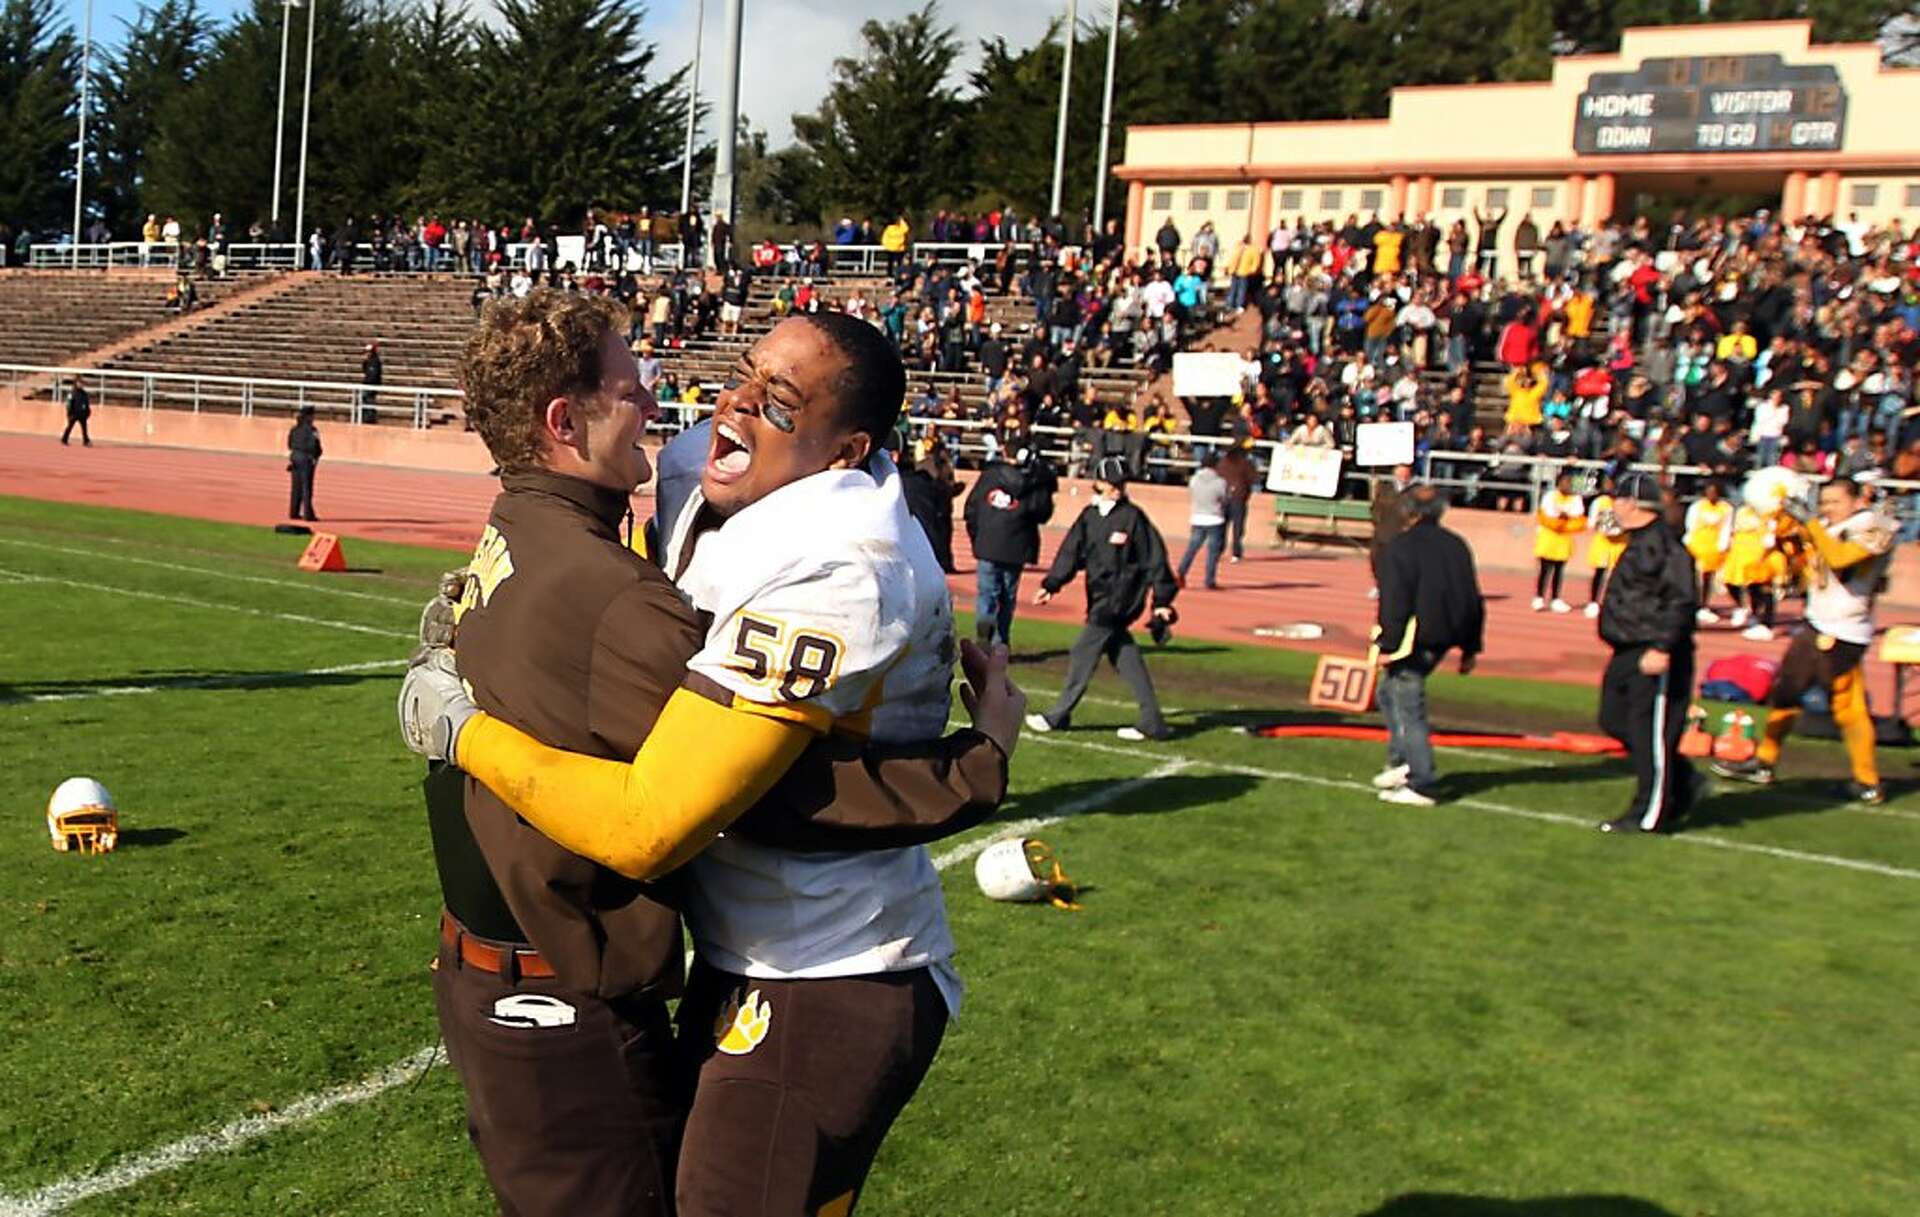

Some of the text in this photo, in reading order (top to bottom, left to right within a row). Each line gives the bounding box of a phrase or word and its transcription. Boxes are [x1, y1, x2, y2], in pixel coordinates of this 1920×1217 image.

[1583, 93, 1655, 118] HOME
[1710, 90, 1793, 114] VISITOR
[1596, 125, 1652, 149] DOWN
[1696, 122, 1757, 147] TO GO
[1790, 121, 1837, 145] QTR
[725, 612, 844, 702] 58
[1318, 663, 1368, 705] 50
